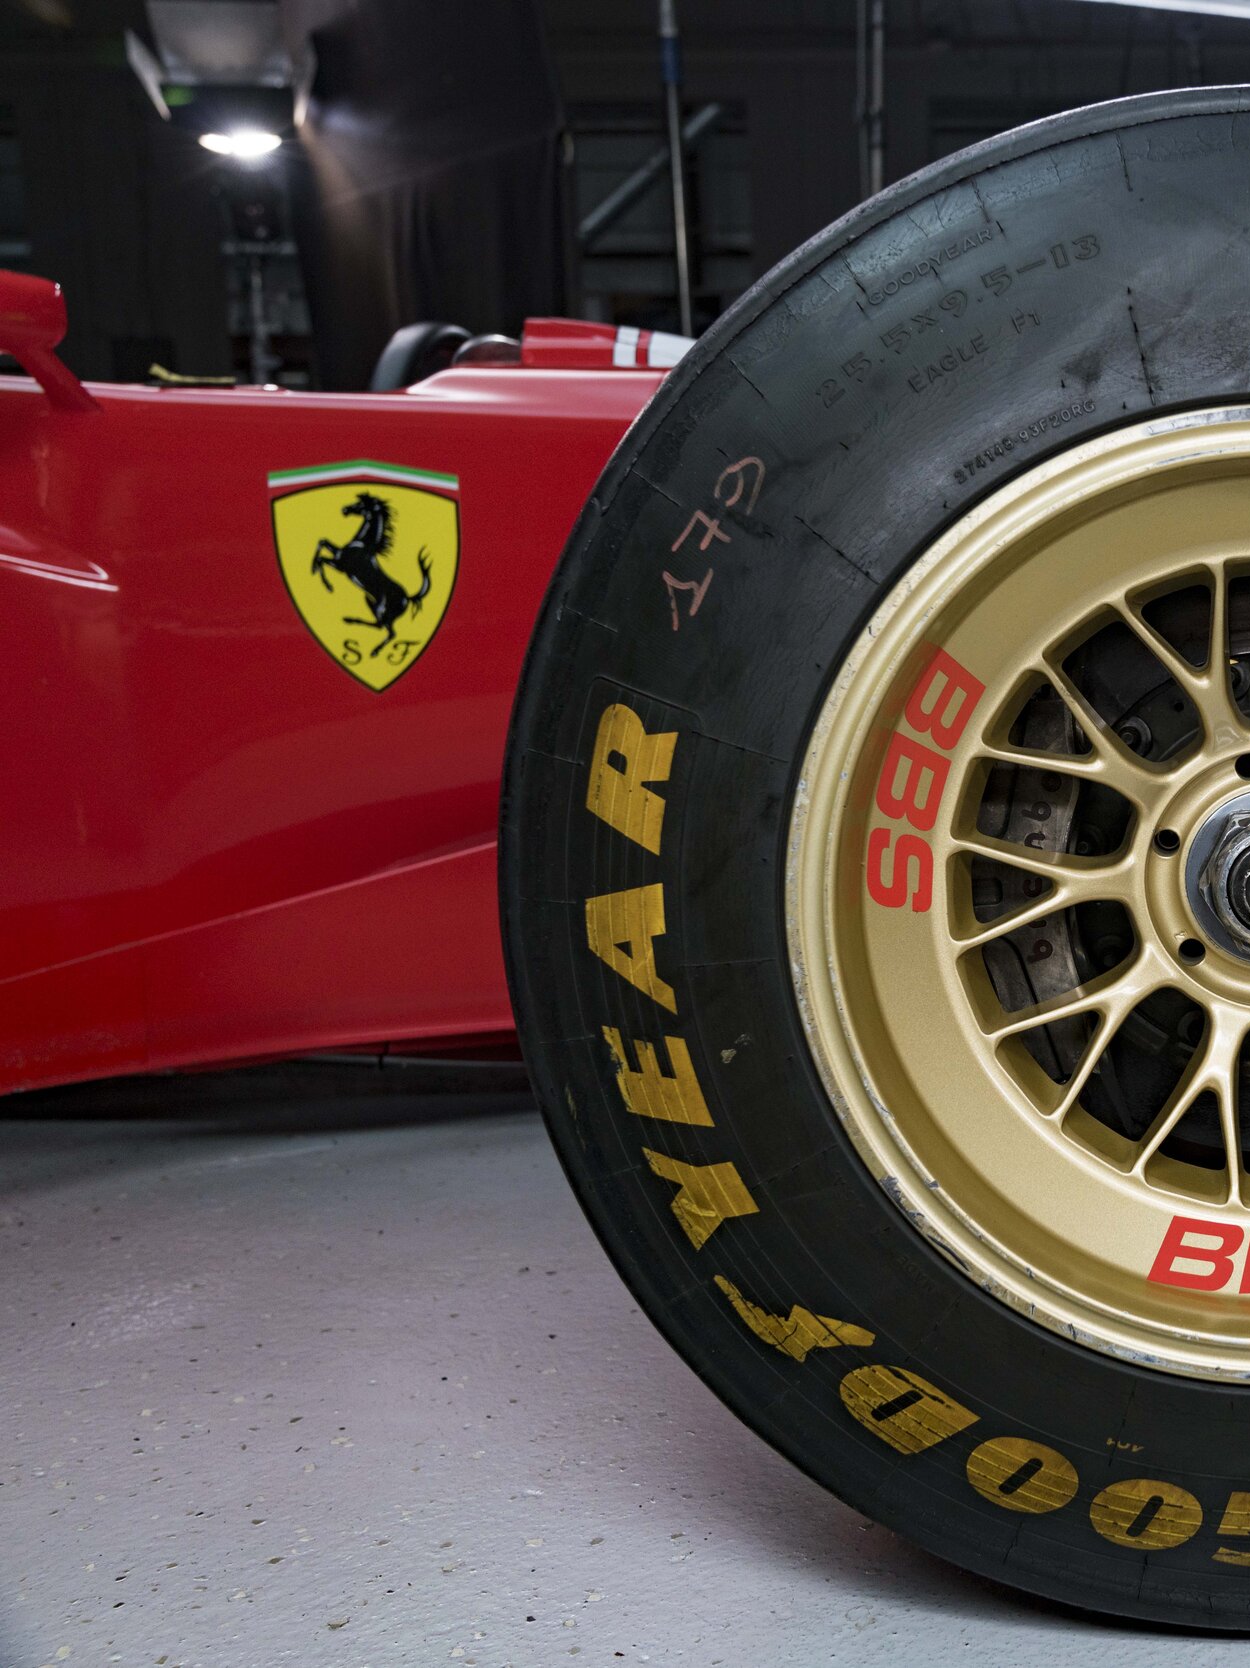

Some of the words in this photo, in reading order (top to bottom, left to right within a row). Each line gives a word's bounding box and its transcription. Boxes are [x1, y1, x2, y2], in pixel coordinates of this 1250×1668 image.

[865, 226, 994, 308] GOODYEAR
[907, 331, 990, 394] EAGLE
[1010, 306, 1042, 335] F1
[867, 645, 986, 912] BBS
